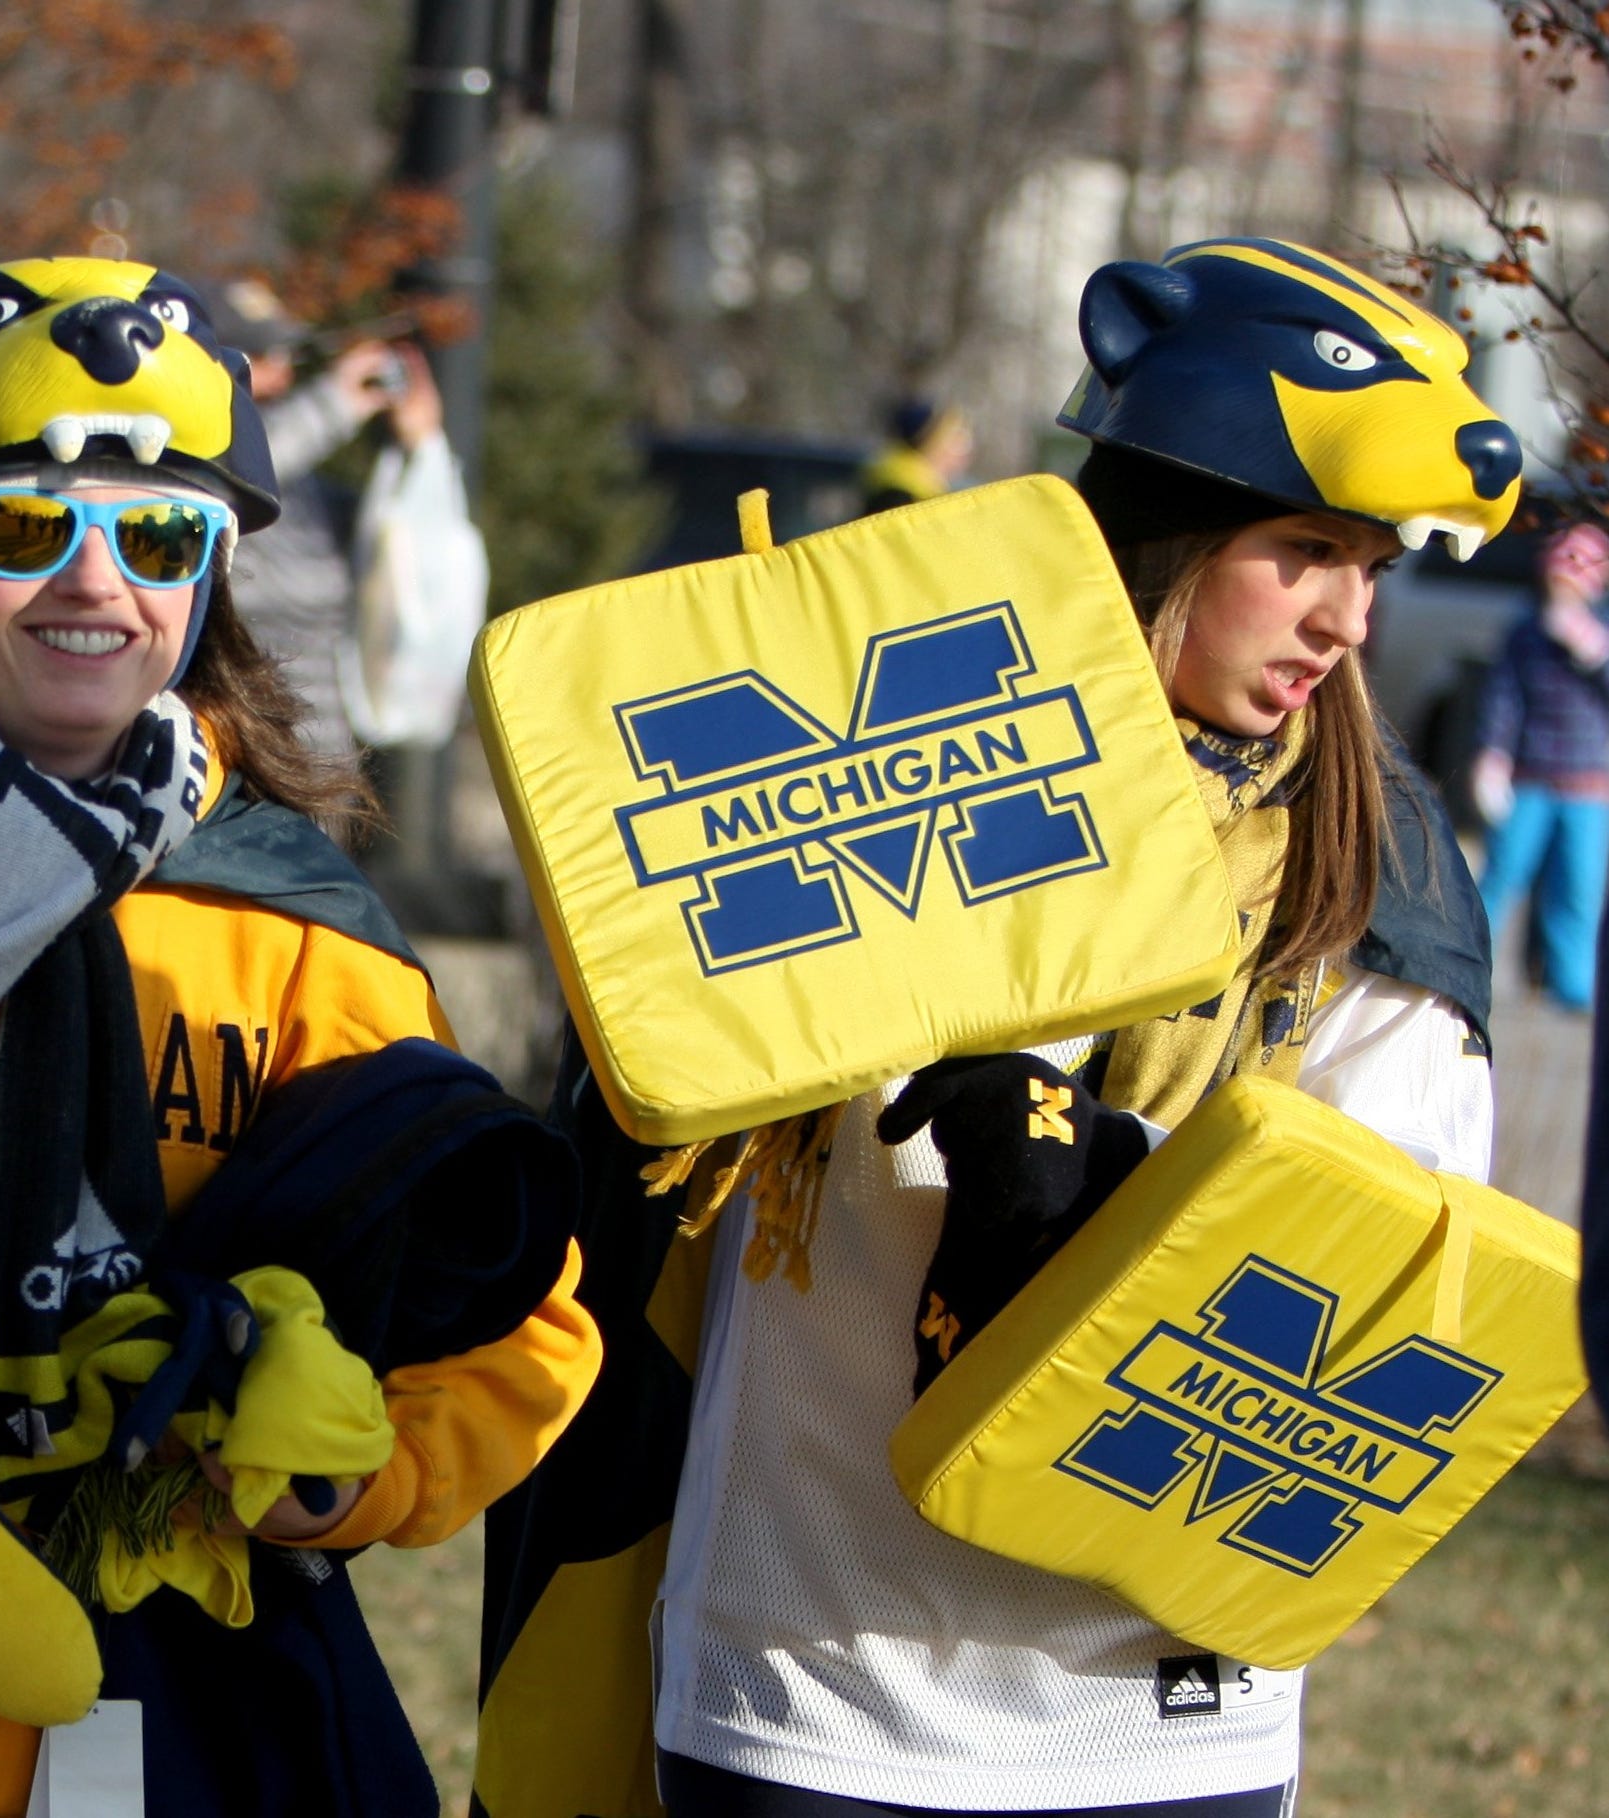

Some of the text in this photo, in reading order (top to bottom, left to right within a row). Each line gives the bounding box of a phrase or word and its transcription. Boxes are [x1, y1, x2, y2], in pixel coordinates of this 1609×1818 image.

[700, 722, 1029, 849] MICHIGAN
[1027, 1077, 1074, 1146] M
[1165, 1362, 1398, 1484] MICHIGAN
[1165, 1690, 1216, 1707] adidas
[1237, 1666, 1254, 1695] S
